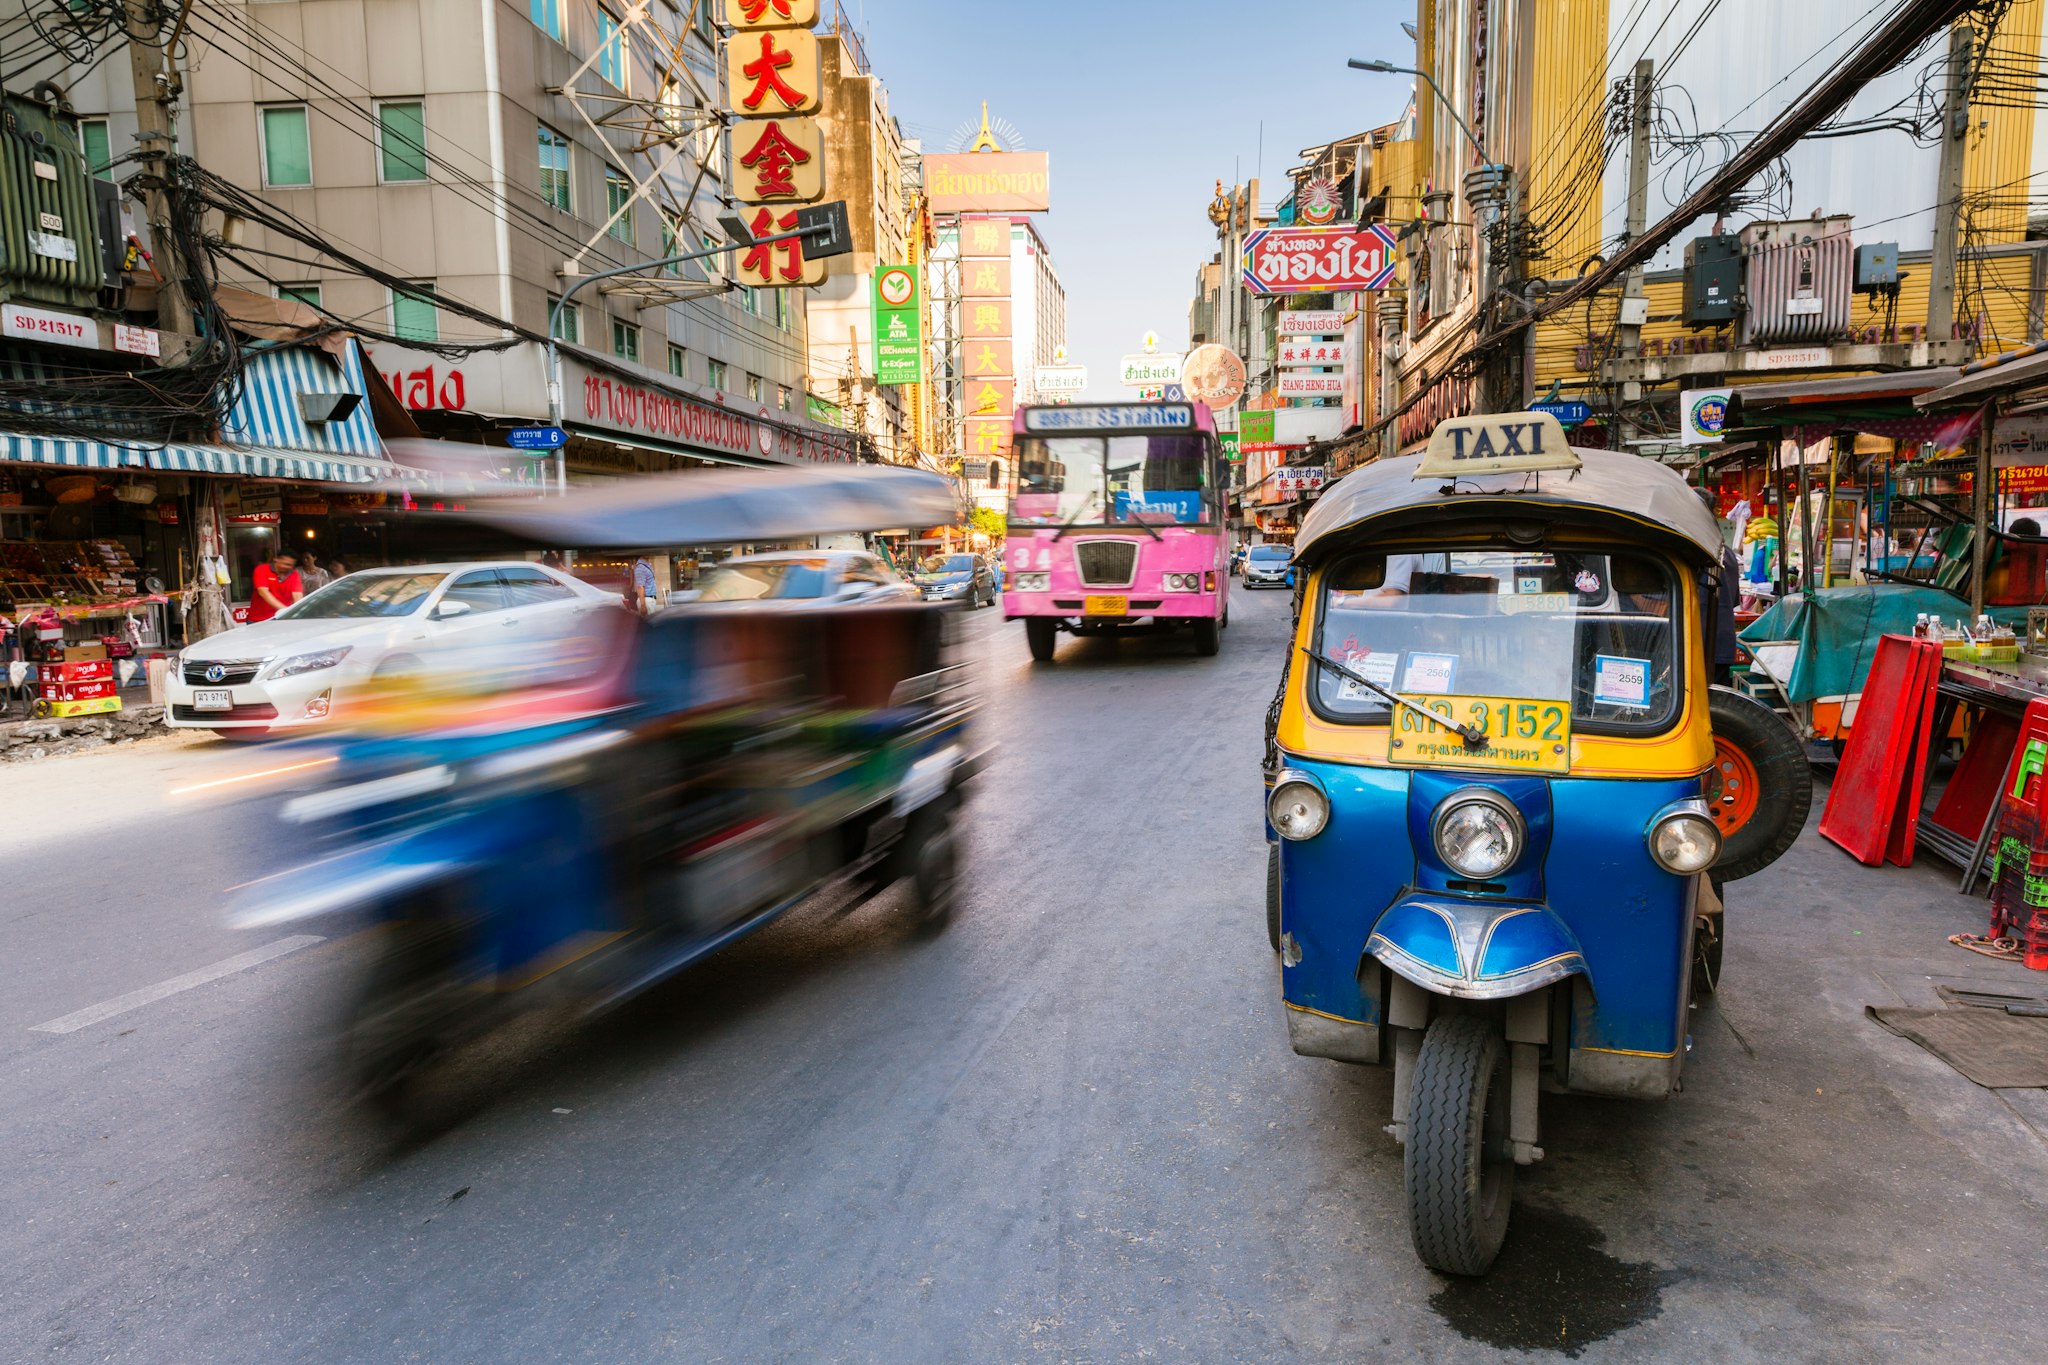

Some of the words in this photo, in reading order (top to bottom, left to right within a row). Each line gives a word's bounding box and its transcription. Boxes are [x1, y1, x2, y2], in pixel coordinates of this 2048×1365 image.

[739, 0, 811, 282] 大金行
[42, 215, 61, 228] 500
[1265, 235, 1326, 252] ห้างทอง
[889, 330, 908, 338] ATM
[972, 225, 1005, 456] 聯成興大金行
[880, 346, 918, 355] EXCHANGE
[881, 358, 915, 369] K-Expert
[1282, 379, 1304, 391] SIANG
[1305, 379, 1325, 391] HENG
[1326, 379, 1342, 391] HUA
[1572, 406, 1583, 417] 11
[551, 431, 558, 442] 6
[1446, 422, 1546, 460] TAXI
[1181, 501, 1188, 515] 2
[1426, 668, 1450, 679] 2560
[1618, 674, 1643, 685] 2559
[211, 693, 228, 702] 9714
[1468, 701, 1563, 741] 3152
